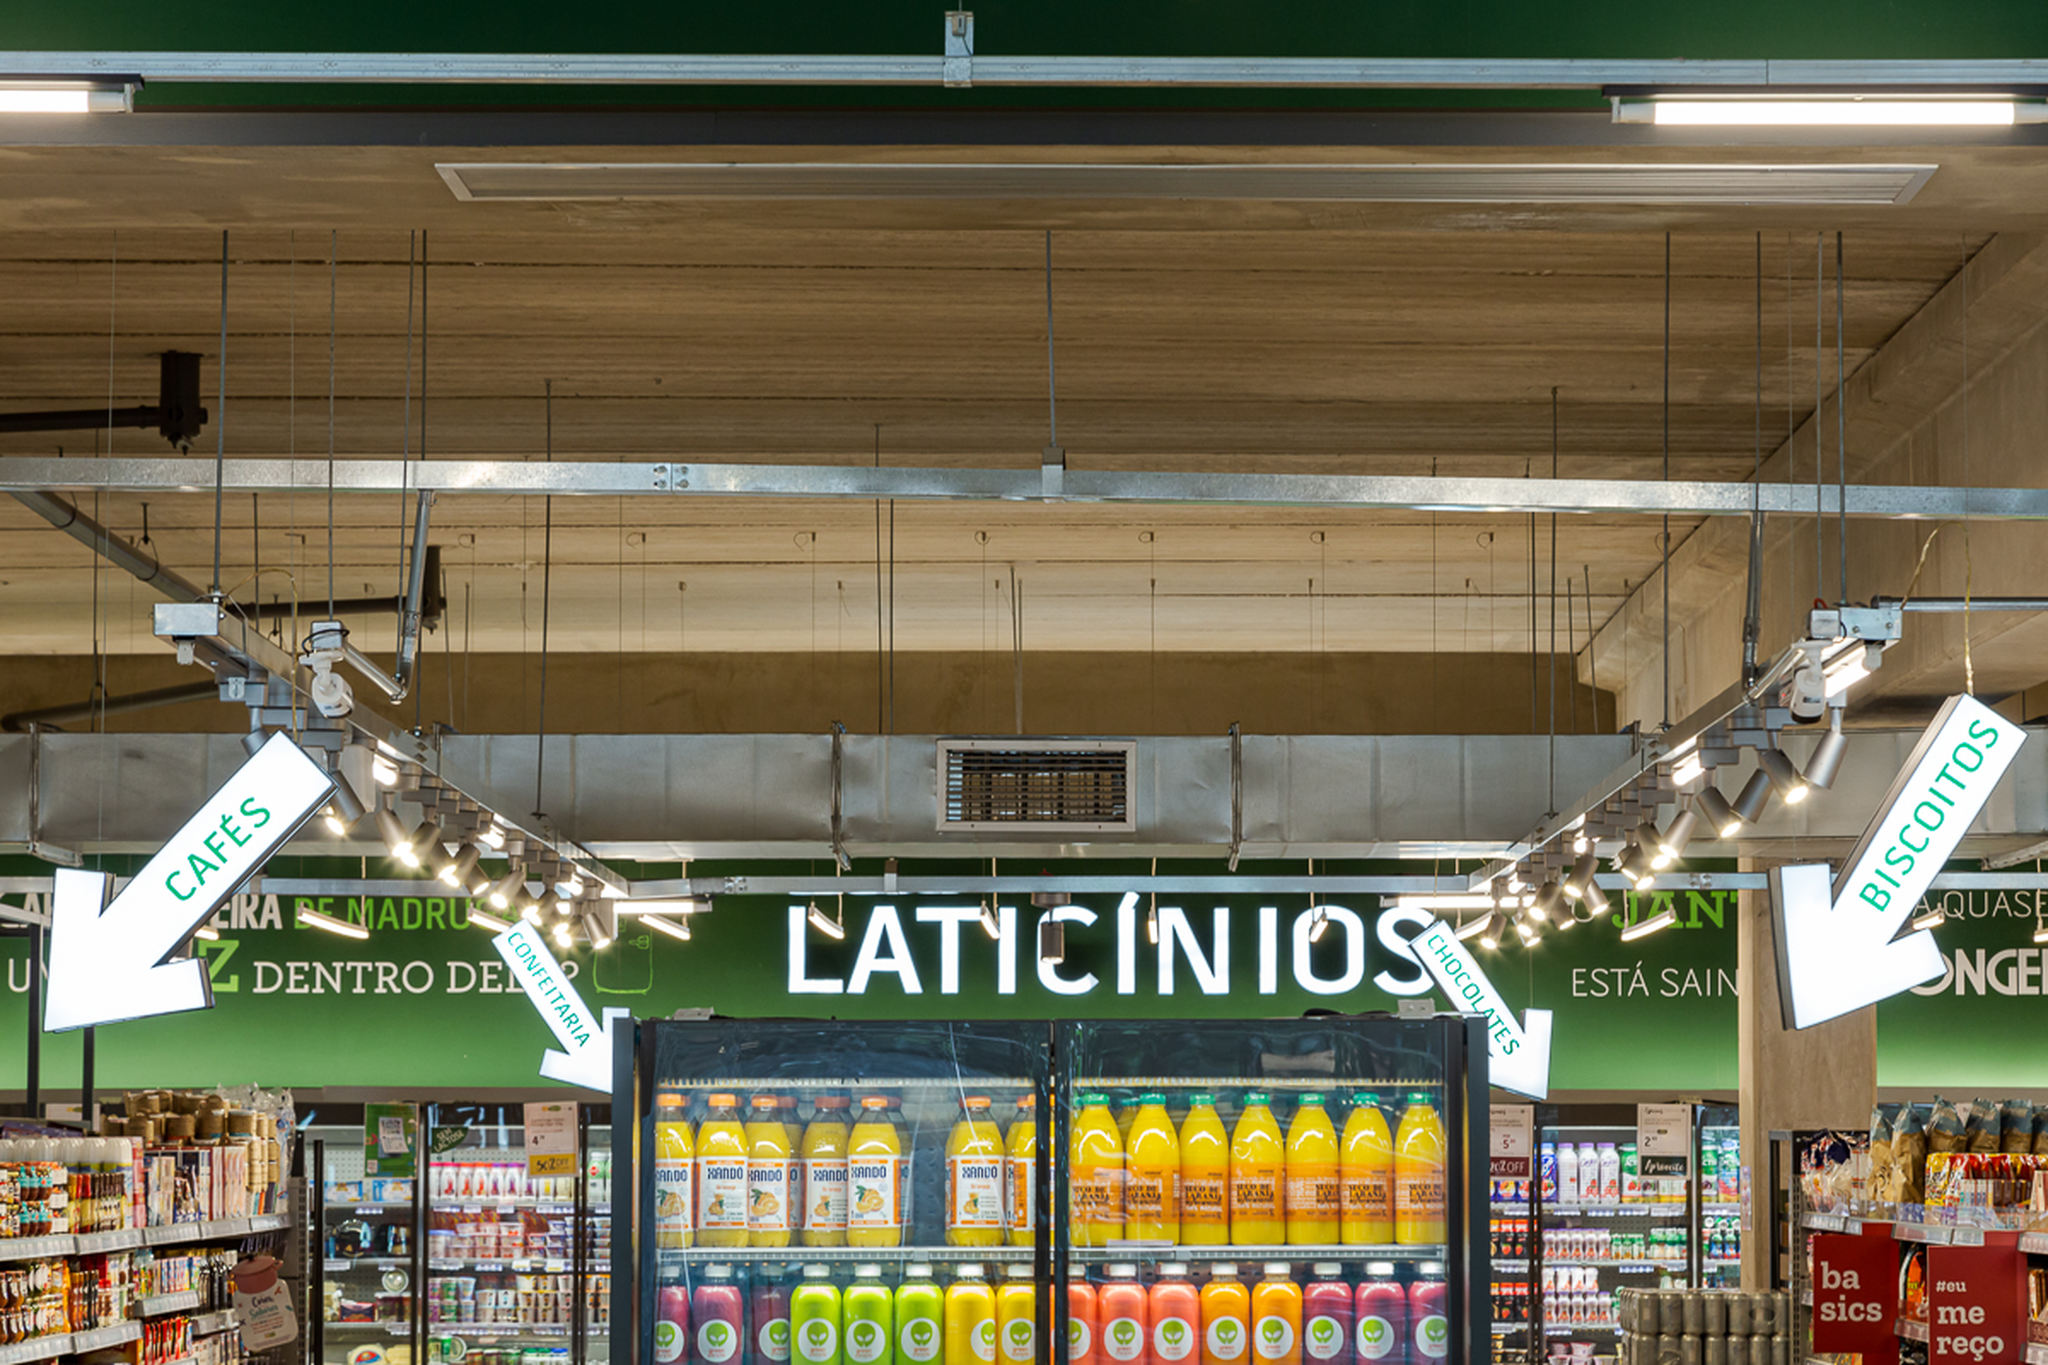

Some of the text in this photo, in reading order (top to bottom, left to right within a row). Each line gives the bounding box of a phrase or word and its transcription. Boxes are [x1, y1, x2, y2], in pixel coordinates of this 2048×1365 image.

[1859, 719, 1999, 912] BISCOITOS
[165, 797, 270, 901] CAFÉS
[1611, 891, 1738, 928] JAN
[788, 891, 1436, 994] LATICÍNIOS
[253, 961, 435, 993] DENTRO
[508, 932, 590, 1047] CONFEITARIA
[1427, 934, 1520, 1055] CHOCOLATES
[1572, 960, 1650, 997] ESTÁ
[1820, 1261, 1861, 1290] ba
[1935, 1280, 1967, 1292] #eu
[1820, 1294, 1883, 1322] sics
[1936, 1304, 1985, 1325] me
[1936, 1335, 2004, 1361] reço
